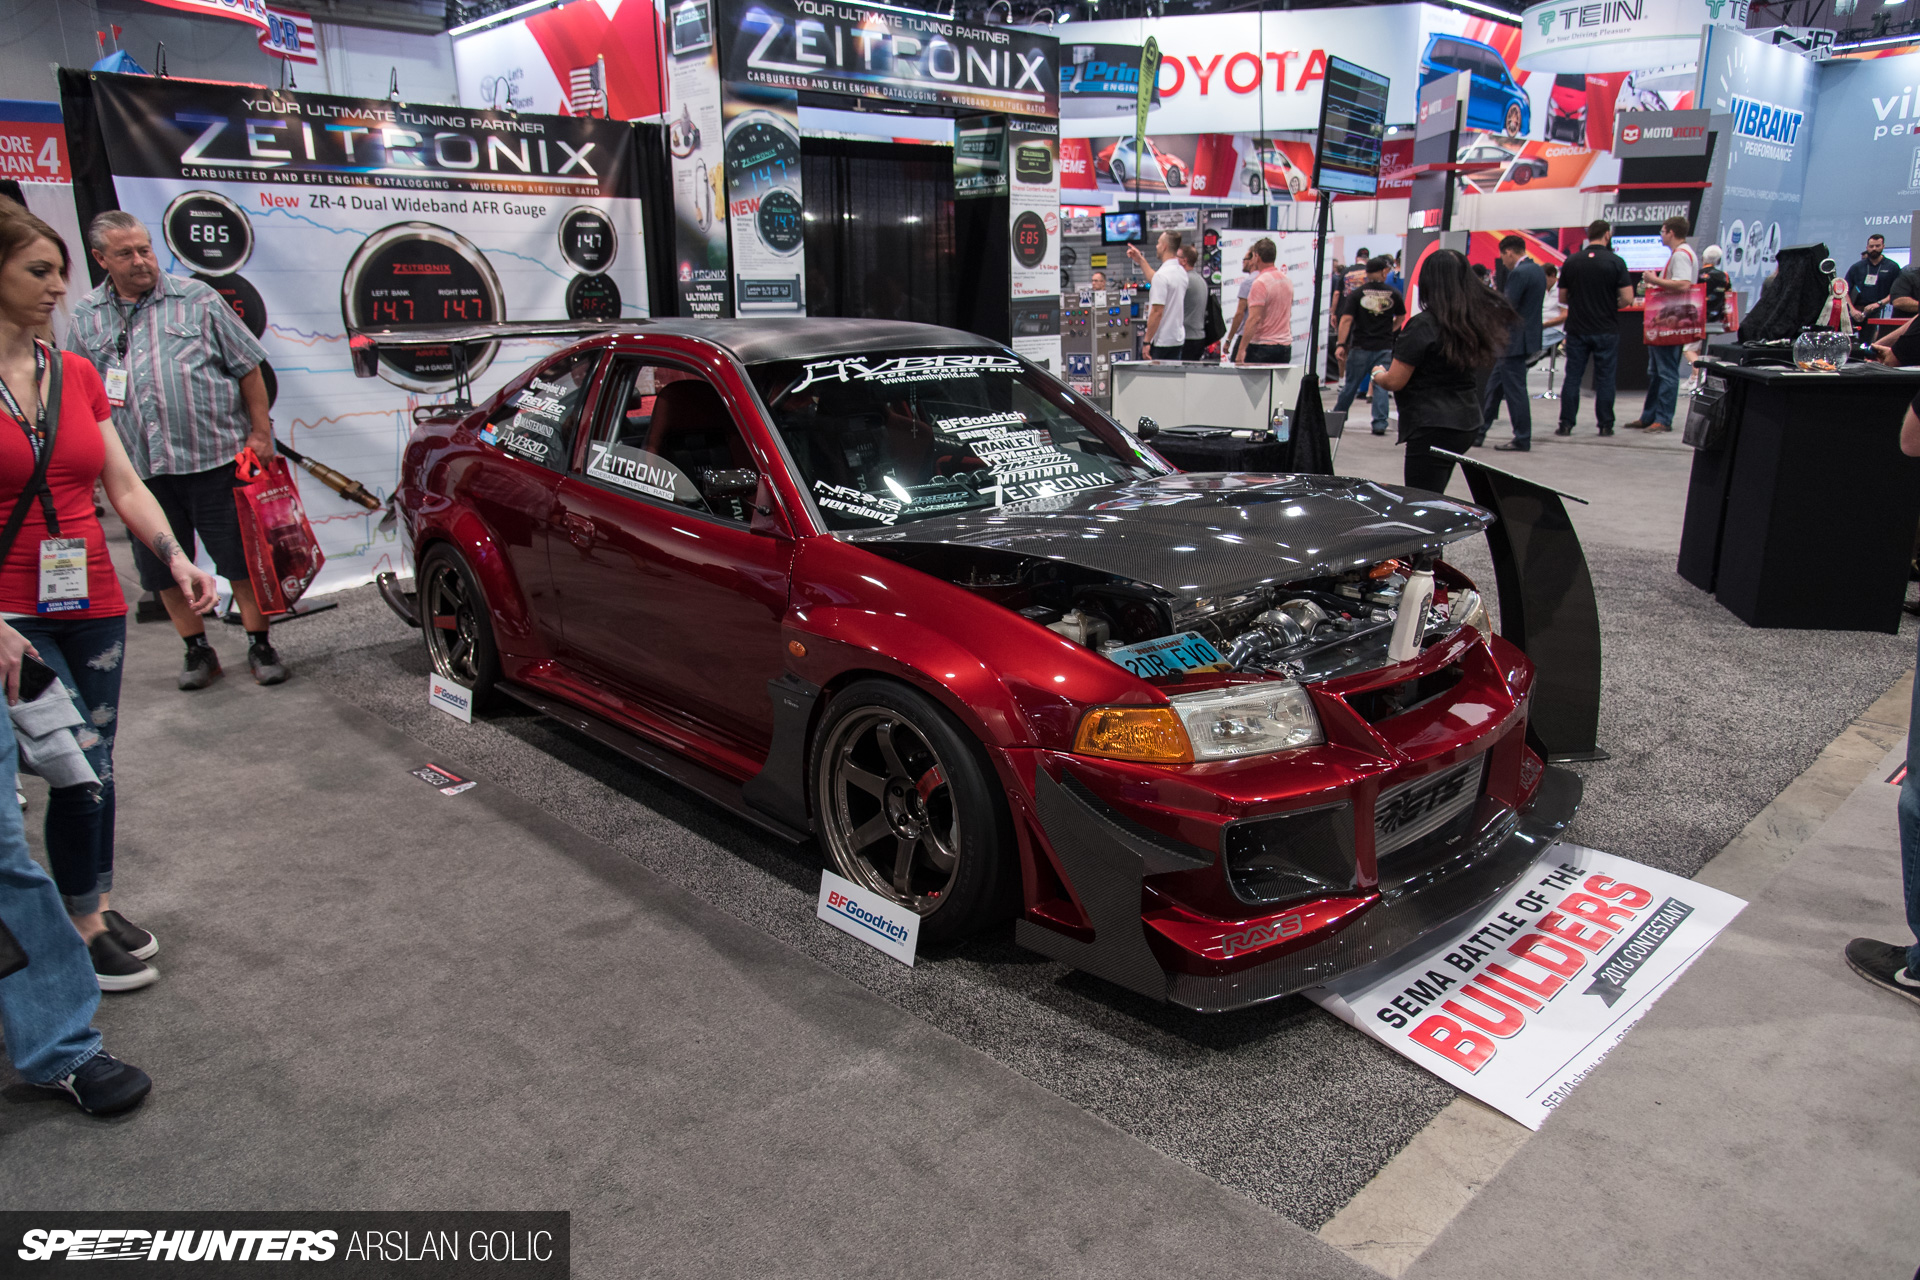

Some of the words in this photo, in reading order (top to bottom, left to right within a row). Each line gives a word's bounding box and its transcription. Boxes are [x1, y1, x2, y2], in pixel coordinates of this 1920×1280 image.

[794, 0, 835, 17] YOUR
[838, 8, 903, 28] ULTIMATE
[906, 17, 953, 36] TUNING
[956, 26, 1010, 44] PARTNER
[1560, 0, 1643, 30] TEIN
[1546, 37, 1556, 45] For
[1572, 31, 1598, 40] Driving
[1600, 26, 1631, 36] Pleasure
[746, 12, 1045, 97] ZEITRONIX
[1159, 49, 1328, 97] OYOTA
[747, 71, 808, 87] CARBURETED
[811, 79, 830, 90] AND
[832, 81, 846, 91] EFI
[849, 83, 879, 95] ENGINE
[883, 86, 937, 101] DATALOGGING
[952, 96, 990, 108] WIDEBAND
[992, 99, 1024, 112] AIR/FUEL
[1026, 102, 1046, 114] RATIO
[1103, 83, 1138, 93] ENGIN
[242, 98, 300, 114] YOUR
[307, 103, 396, 122] ULTIMATE
[401, 112, 466, 128] TUNING
[471, 118, 545, 134] PARTNER
[1732, 93, 1804, 146] VIBRANT
[1643, 126, 1704, 139] MOTOVICITY
[37, 137, 61, 174] 4
[175, 112, 598, 181] ZEITRONIX
[1545, 147, 1592, 158] COROLLA
[1744, 141, 1793, 161] PERFORMANCE
[182, 168, 267, 181] CARBURETED
[273, 172, 298, 182] AND
[304, 174, 323, 183] EFI
[327, 175, 370, 186] ENGINE
[375, 176, 450, 189] DATALOGGING
[470, 182, 524, 193] WIDEBAND
[528, 184, 572, 195] AIR/FUEL
[575, 186, 600, 196] RATIO
[1192, 175, 1207, 190] 86
[260, 192, 300, 208] New
[308, 194, 347, 210] ZR-4
[352, 195, 387, 210] Dual
[391, 196, 468, 213] Wideband
[472, 201, 500, 214] AFR
[503, 203, 547, 218] Gauge
[730, 197, 760, 217] NEW
[1603, 206, 1637, 223] SALES
[1637, 210, 1643, 219] &
[1643, 204, 1688, 222] SERVICE
[189, 224, 230, 243] E85
[1020, 231, 1039, 245] E85
[392, 263, 451, 274] ZEITRONIX
[680, 270, 727, 281] ITRONIX
[685, 292, 724, 302] ULTIMATE
[690, 303, 720, 312] TUNING
[373, 300, 414, 321] 14.7
[443, 299, 482, 320] 14.7
[1659, 328, 1702, 337] SPYDER
[880, 371, 979, 385] www.teamhybrid.com
[936, 411, 1027, 430] BFGoodrich
[496, 429, 548, 455] HYBRID
[956, 426, 1008, 440] ENERGY
[974, 435, 1035, 455] MANLEY
[999, 445, 1056, 460] Merrill
[586, 444, 677, 491] ZEITRONIX
[995, 462, 1079, 485] MISHIMOTO
[588, 468, 620, 483] WIDEBAND
[622, 479, 650, 493] AIR/FUEL
[653, 489, 673, 500] RATIO
[977, 471, 1114, 512] ZEITRONIX
[818, 497, 898, 526] version2
[1124, 654, 1169, 679] 2DR
[1170, 643, 1218, 670] EVO
[434, 685, 468, 708] BFGoodrich
[827, 890, 908, 942] BFGoodrich
[1222, 914, 1303, 955] RAYS
[1377, 970, 1457, 1029] SEMA
[1443, 911, 1527, 974] BATTLE
[1514, 889, 1554, 913] OF
[1539, 862, 1587, 893] THE
[1600, 957, 1635, 986] 2016
[1624, 899, 1689, 962] CONTESTANT
[1408, 874, 1653, 1076] BUILDERS
